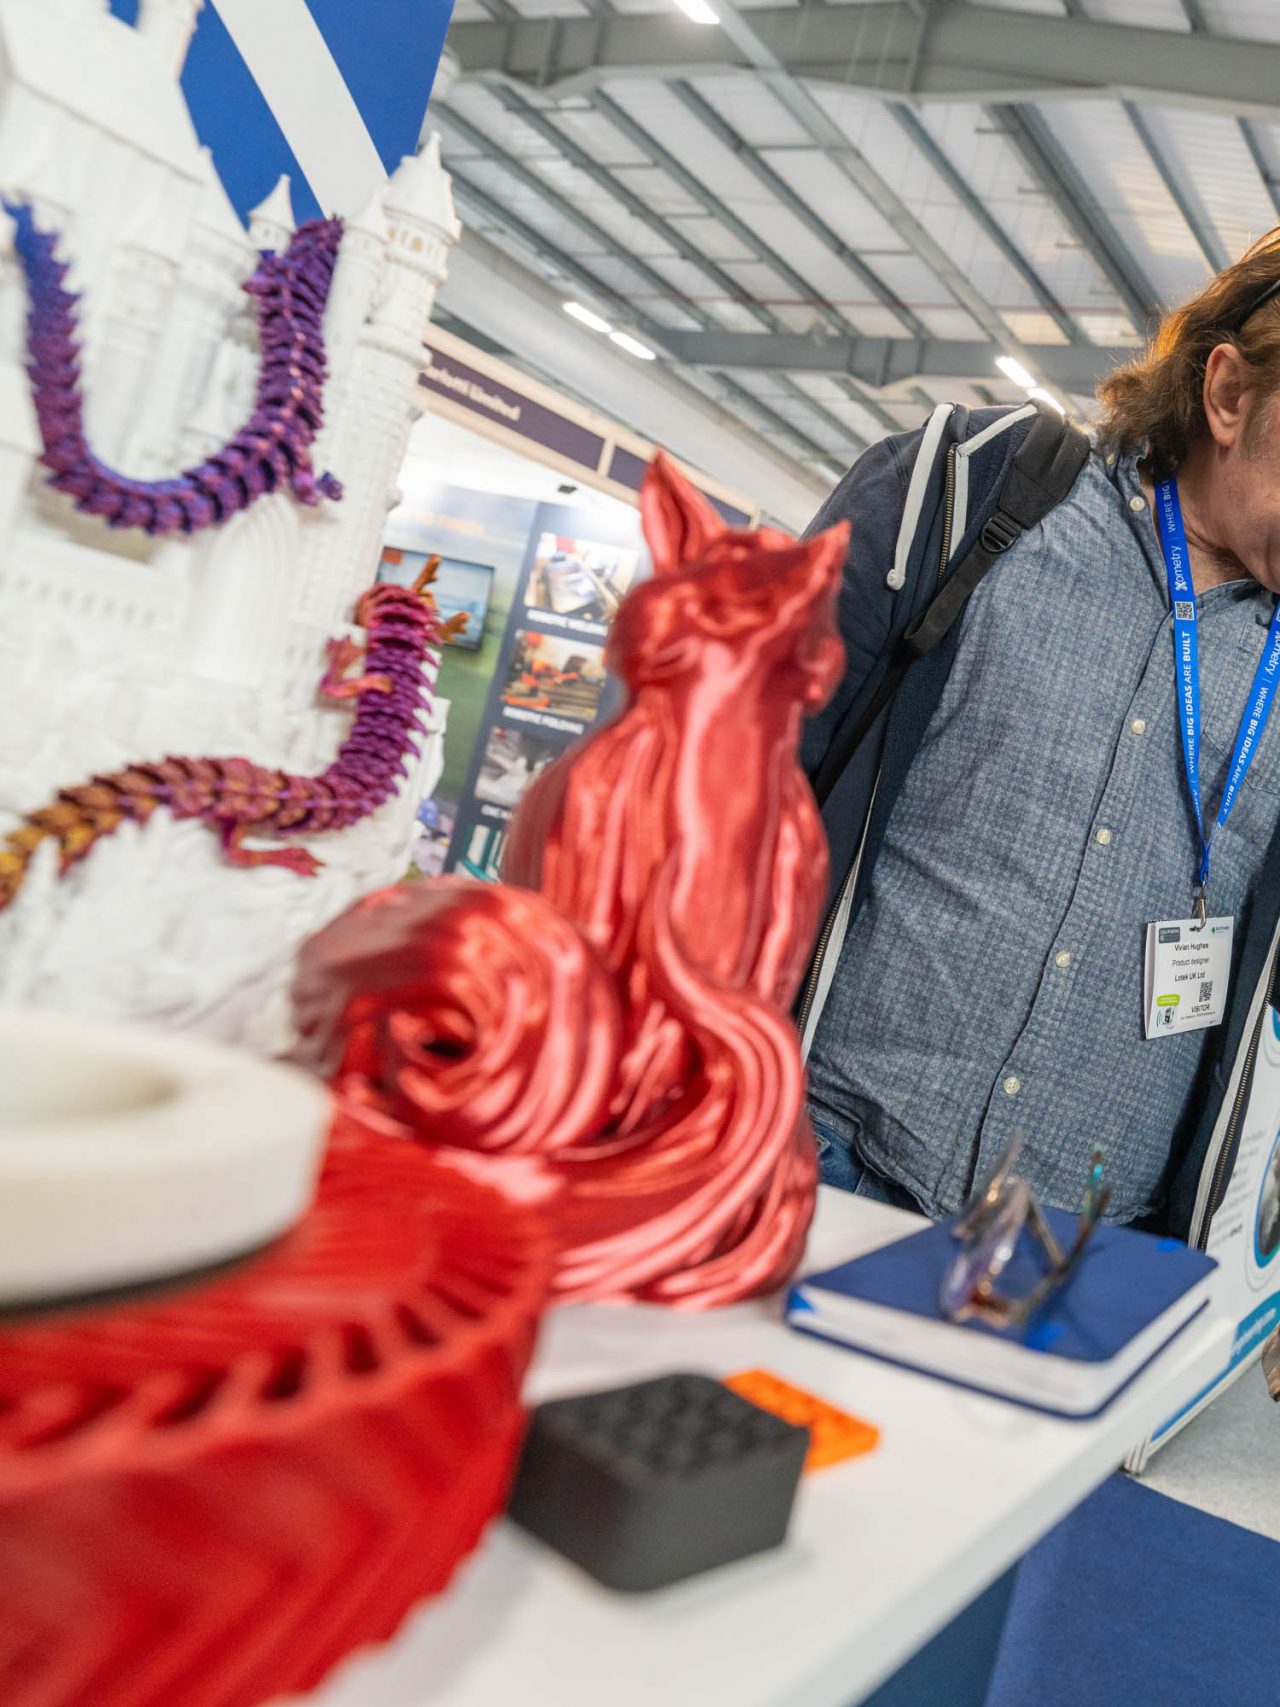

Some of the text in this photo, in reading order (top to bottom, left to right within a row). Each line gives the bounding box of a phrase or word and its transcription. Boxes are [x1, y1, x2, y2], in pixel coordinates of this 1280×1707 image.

[1162, 485, 1172, 500] BIG
[1164, 501, 1177, 533] WHERE
[1171, 546, 1188, 591] Xometry
[1182, 631, 1191, 662] BUILT
[1183, 664, 1192, 683] ARE
[1184, 685, 1194, 715] IDEAS
[1253, 687, 1268, 718] WHERE
[1249, 719, 1259, 735] BIG
[1239, 733, 1255, 766] IDEAS
[1232, 766, 1244, 785] ARE
[1221, 786, 1238, 815] BUILT
[1175, 942, 1209, 951] Vivian Hughes
[1172, 957, 1210, 967] Product designer
[1189, 972, 1197, 980] UK
[1197, 971, 1206, 979] Ltd
[1191, 1003, 1210, 1013] VISITOR
